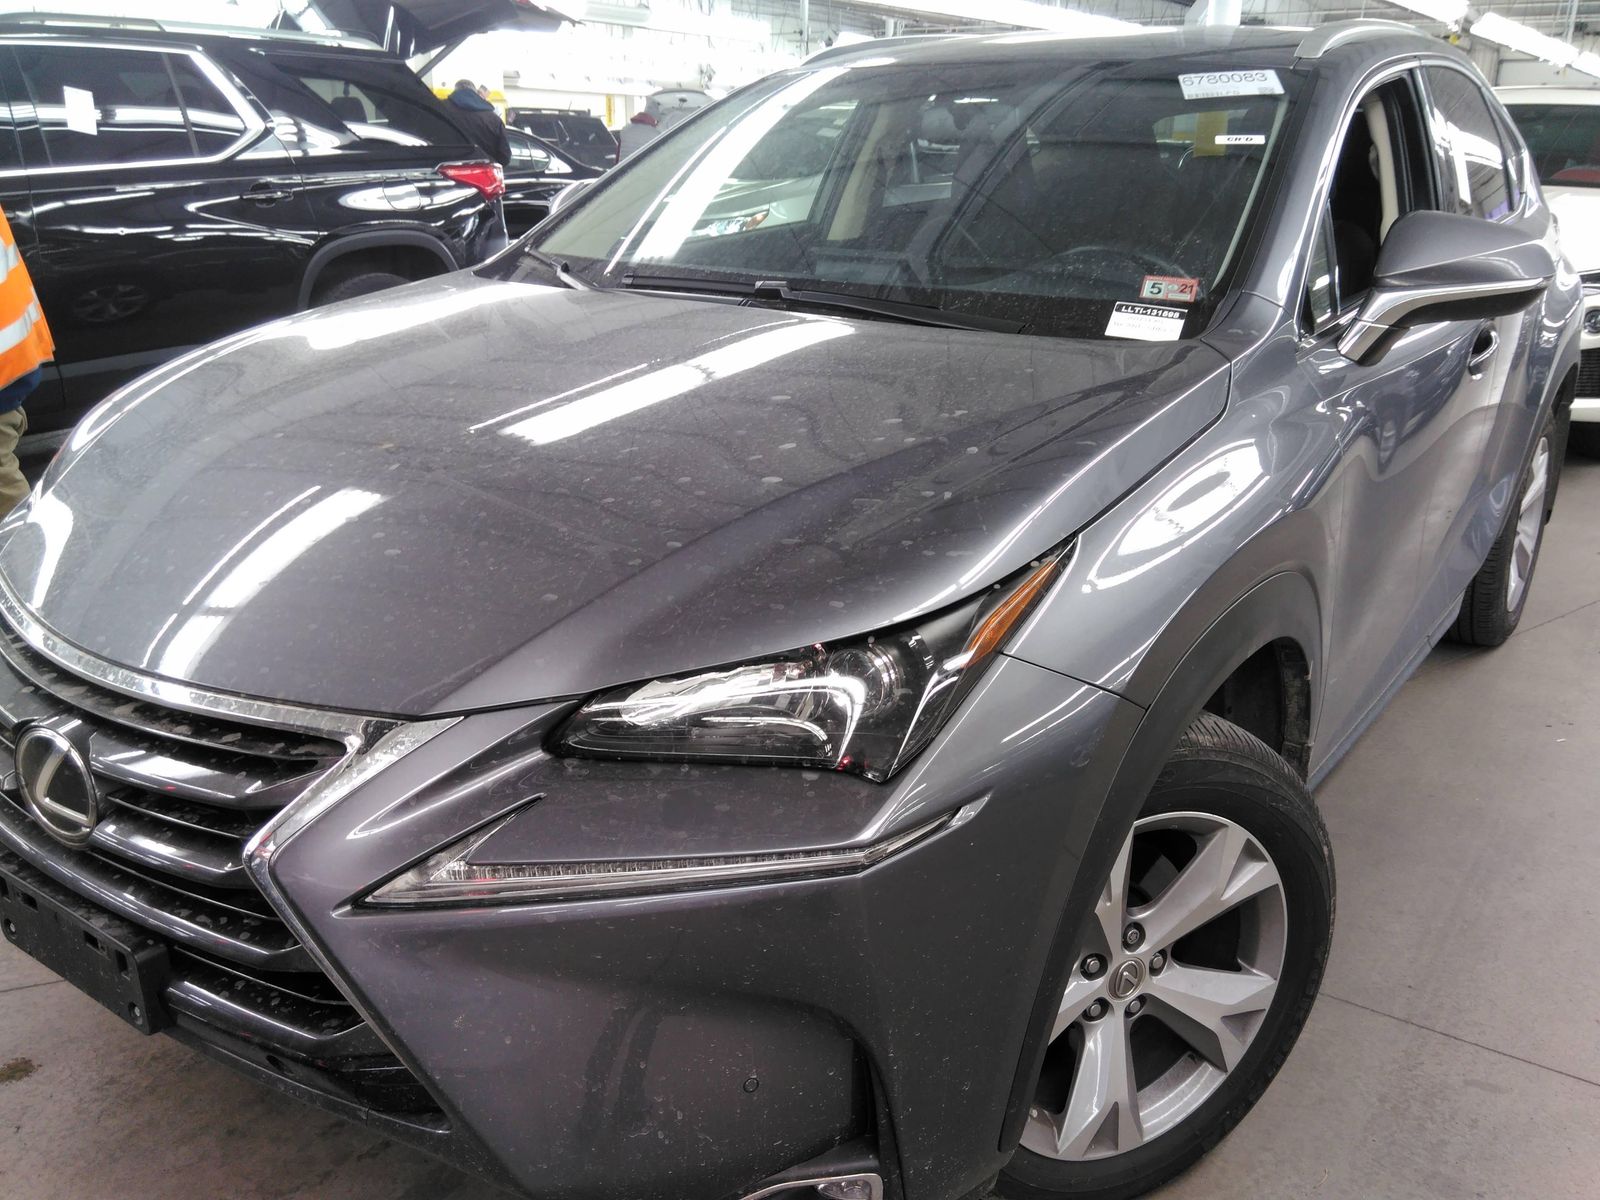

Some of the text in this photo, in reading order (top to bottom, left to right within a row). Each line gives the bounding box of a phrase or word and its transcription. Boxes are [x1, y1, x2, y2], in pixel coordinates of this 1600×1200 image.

[1182, 72, 1268, 87] 6780083
[1149, 282, 1194, 295] 5 21
